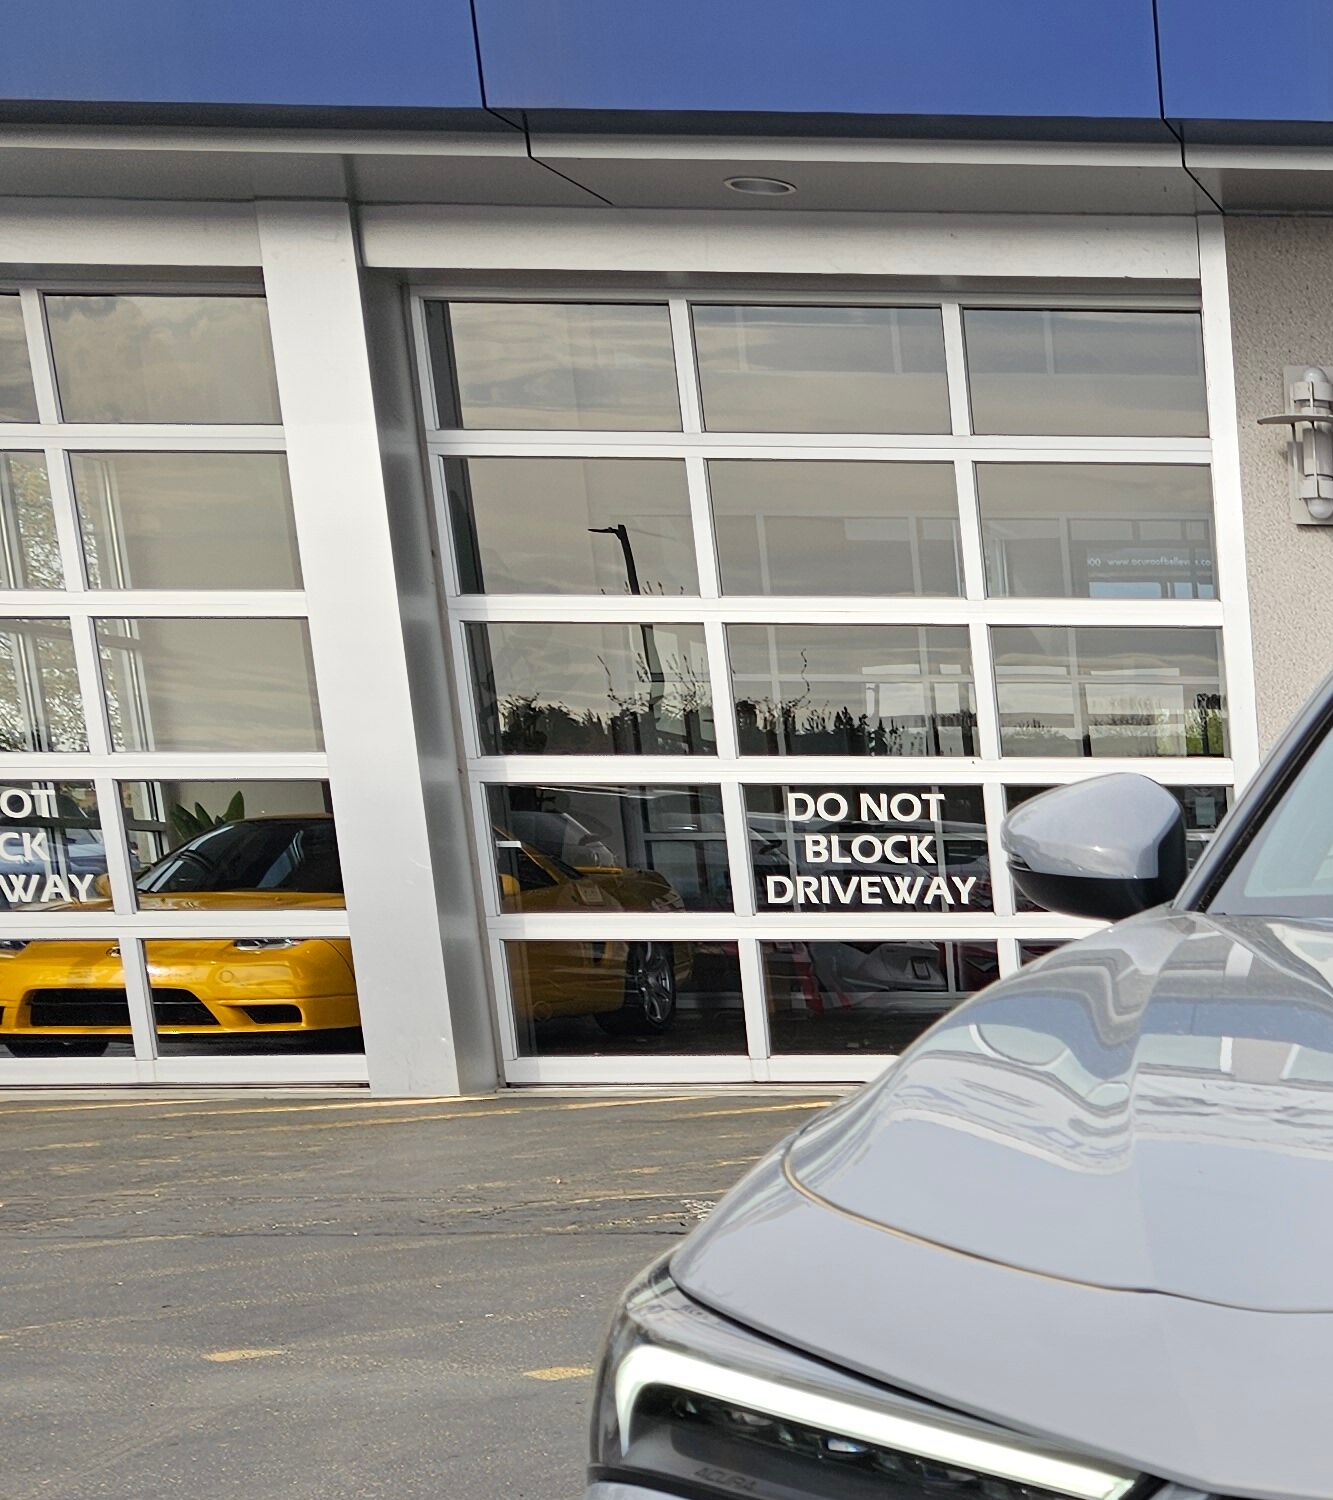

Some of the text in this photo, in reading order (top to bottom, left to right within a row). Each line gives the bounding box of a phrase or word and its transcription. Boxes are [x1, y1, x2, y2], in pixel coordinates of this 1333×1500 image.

[0, 788, 57, 819] OT
[786, 792, 945, 822] DO NOT
[0, 832, 51, 863] CK
[805, 834, 936, 864] BLOCK
[0, 873, 95, 903] WAY
[766, 875, 977, 905] DRIVEWAY
[694, 1466, 757, 1491] ACURA
